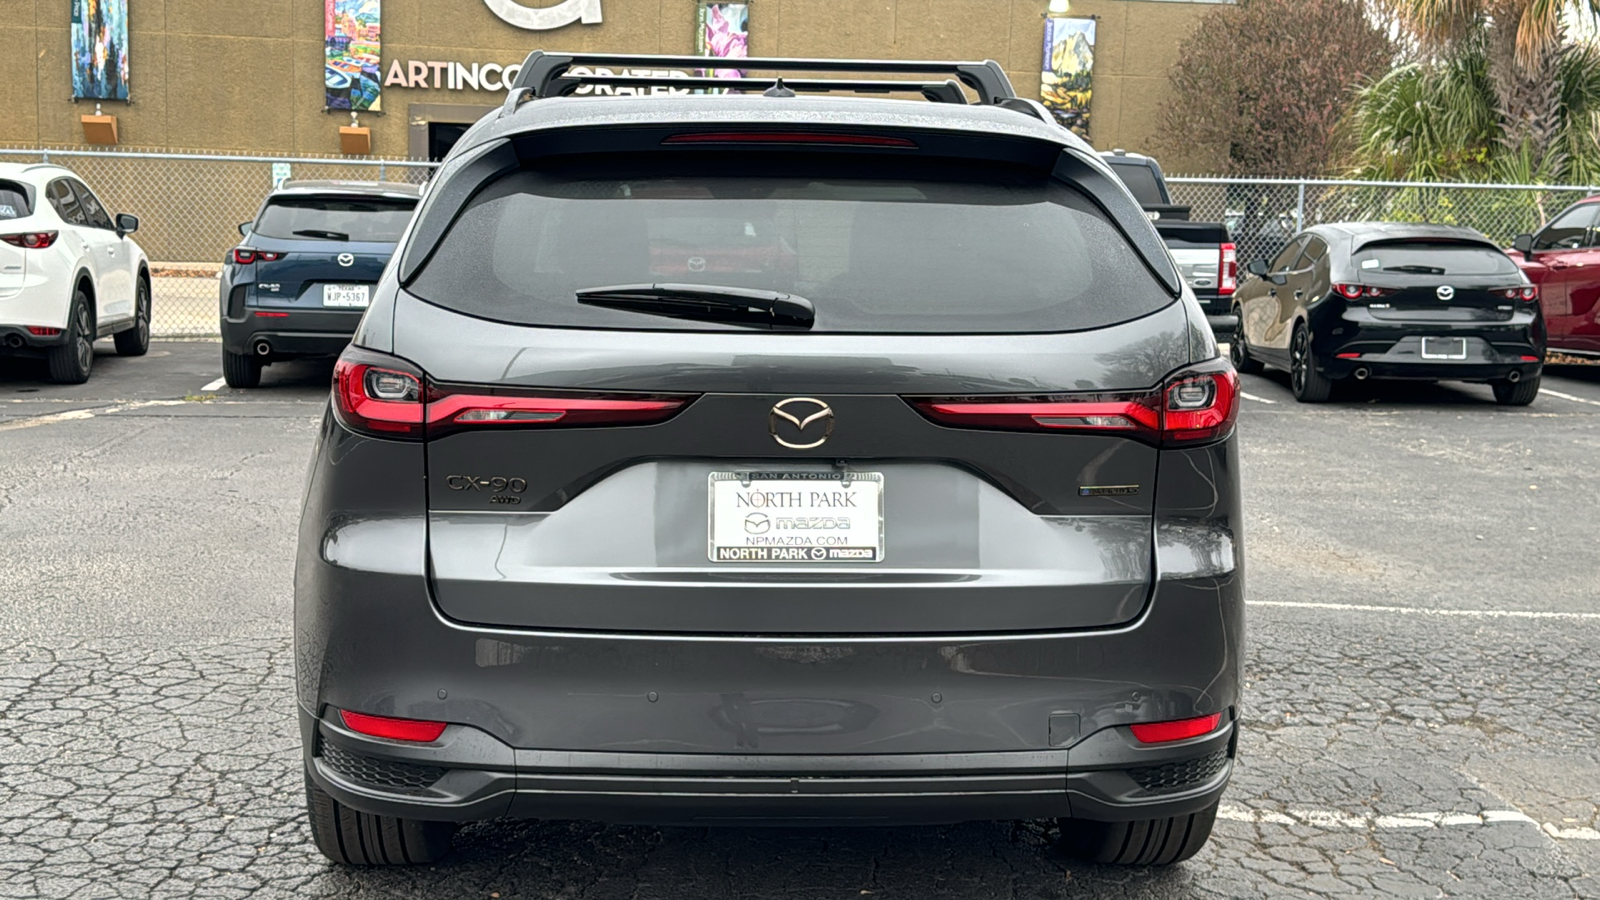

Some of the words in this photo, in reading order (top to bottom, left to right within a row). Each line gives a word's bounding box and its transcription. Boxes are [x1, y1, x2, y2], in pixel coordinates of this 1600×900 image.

[446, 475, 527, 493] CX-90
[489, 495, 521, 504] AWD
[736, 491, 802, 508] NORTH
[809, 492, 857, 507] PARK
[776, 517, 851, 530] mazda
[719, 548, 768, 560] NORTH
[771, 548, 809, 560] PARK
[829, 550, 874, 558] mazda
